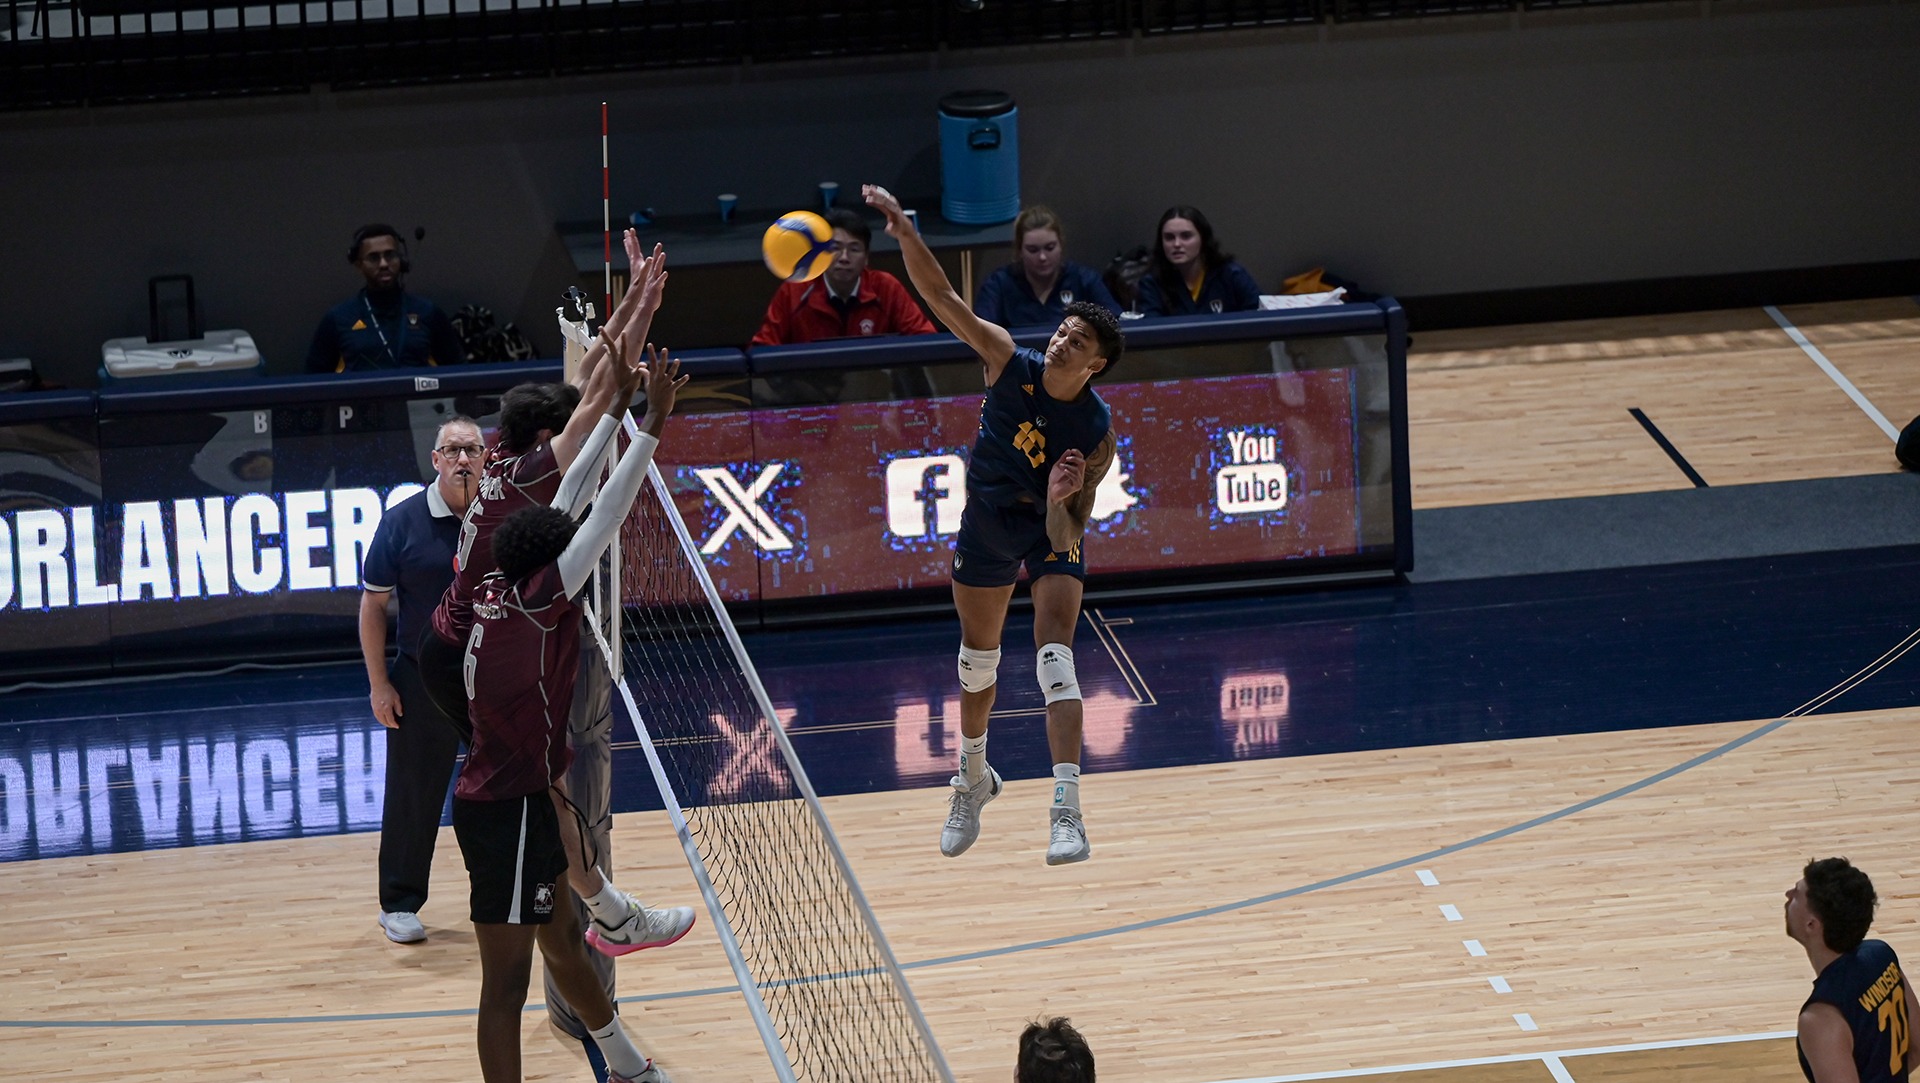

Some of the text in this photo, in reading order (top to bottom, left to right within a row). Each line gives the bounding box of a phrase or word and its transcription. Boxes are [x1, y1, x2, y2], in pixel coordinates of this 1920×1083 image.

[253, 411, 268, 434] B
[339, 406, 353, 429] P
[1227, 431, 1277, 465] You
[1222, 471, 1281, 505] Tube
[0, 483, 428, 610] RLANCER
[463, 622, 484, 700] 6
[1859, 961, 1900, 1013] WINDSOR
